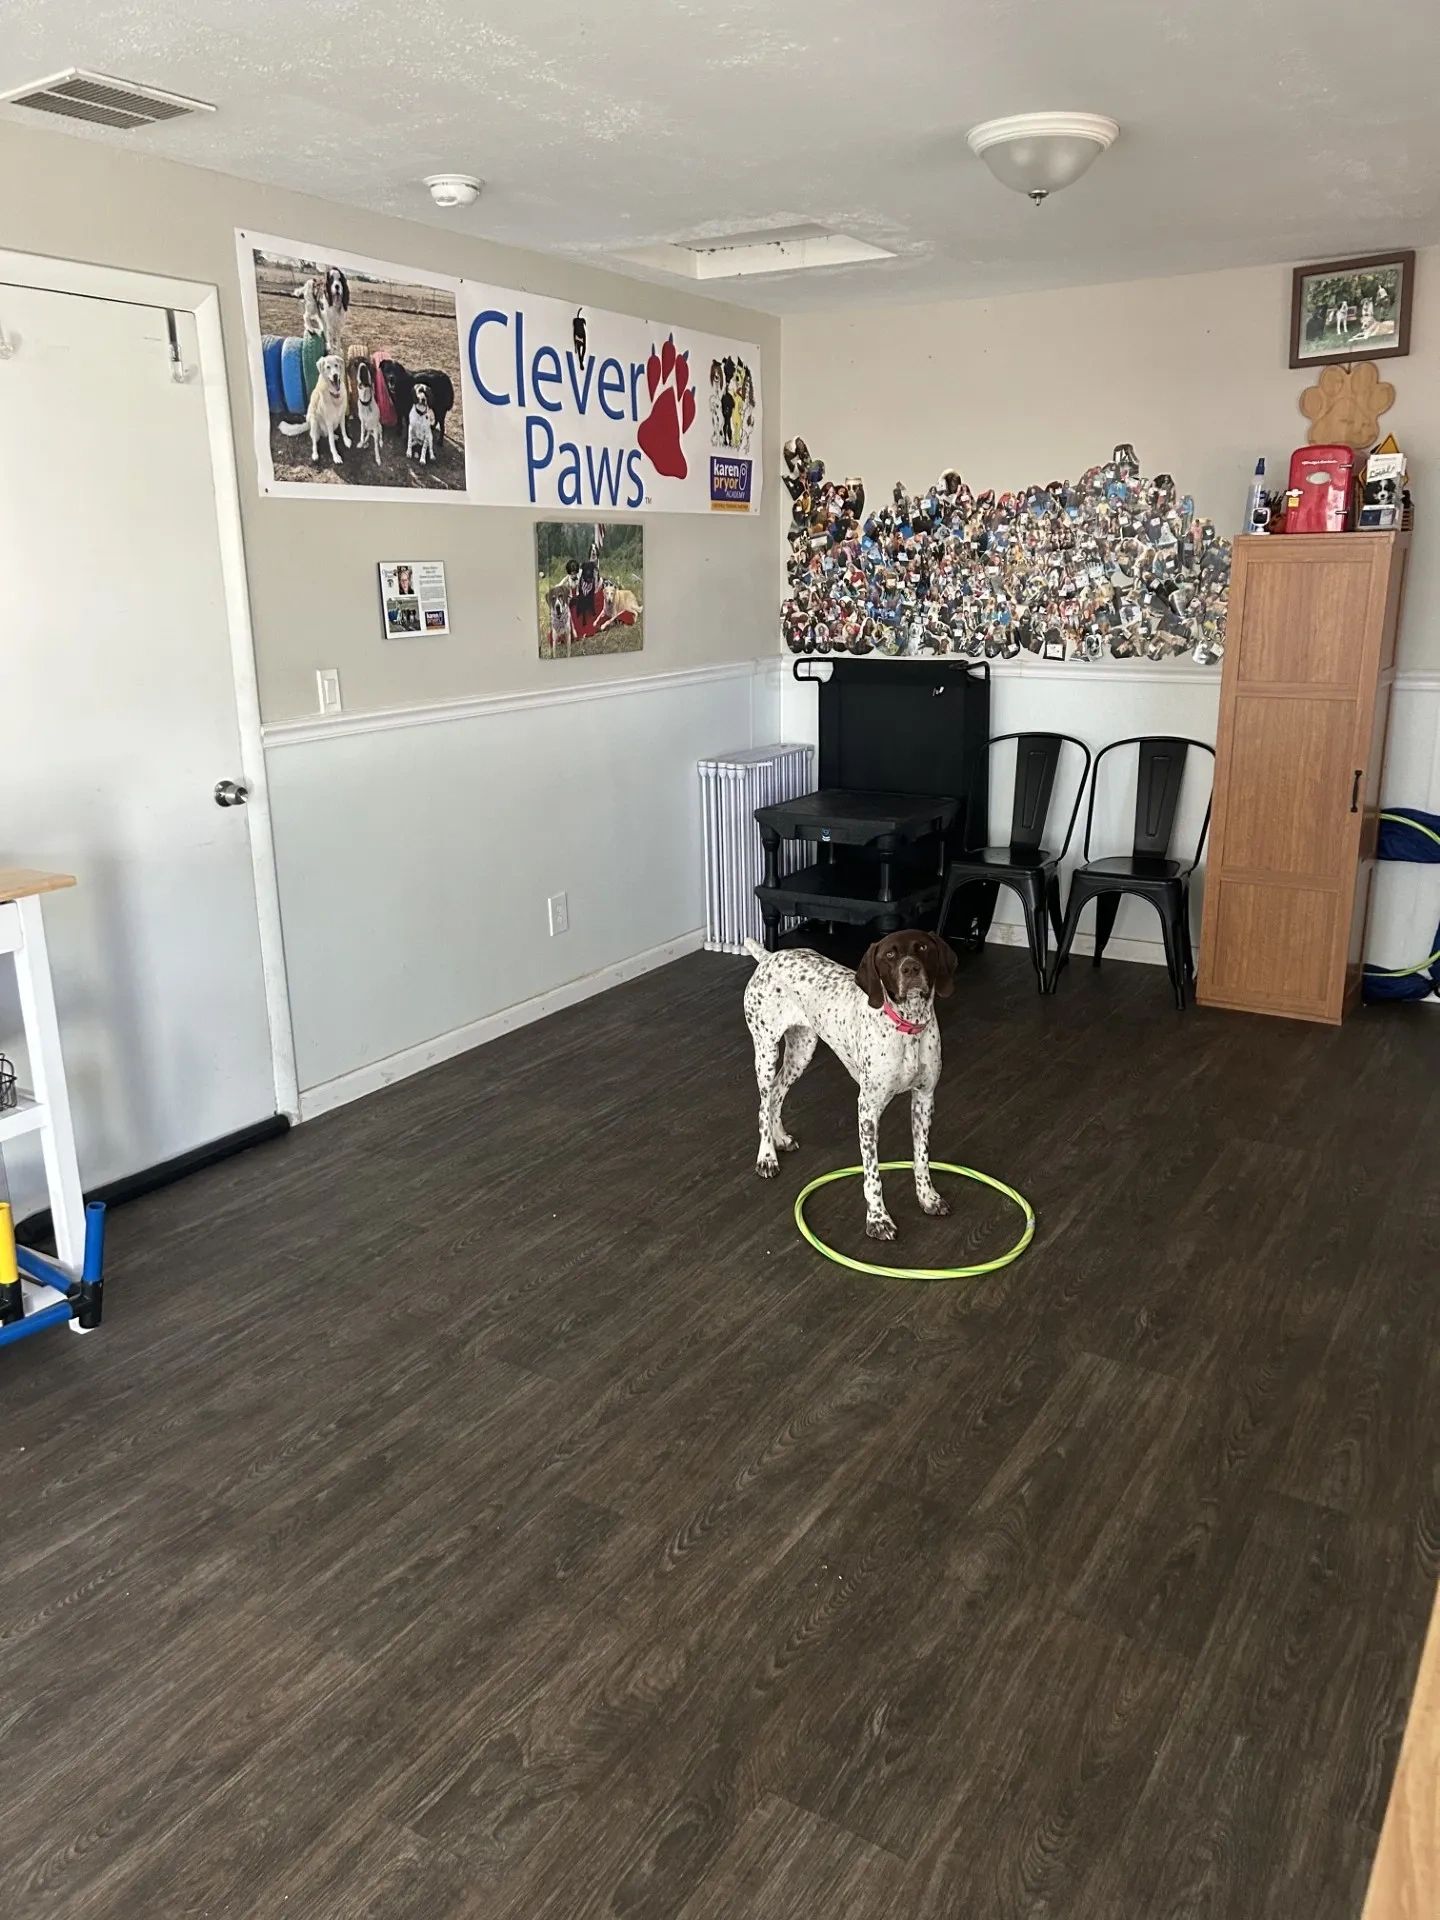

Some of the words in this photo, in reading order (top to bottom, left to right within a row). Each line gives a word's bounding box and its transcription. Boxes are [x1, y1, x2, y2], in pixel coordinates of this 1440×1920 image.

[468, 309, 645, 422] Clever
[525, 415, 645, 508] Paws
[713, 458, 739, 477] karen
[713, 476, 739, 492] pryor
